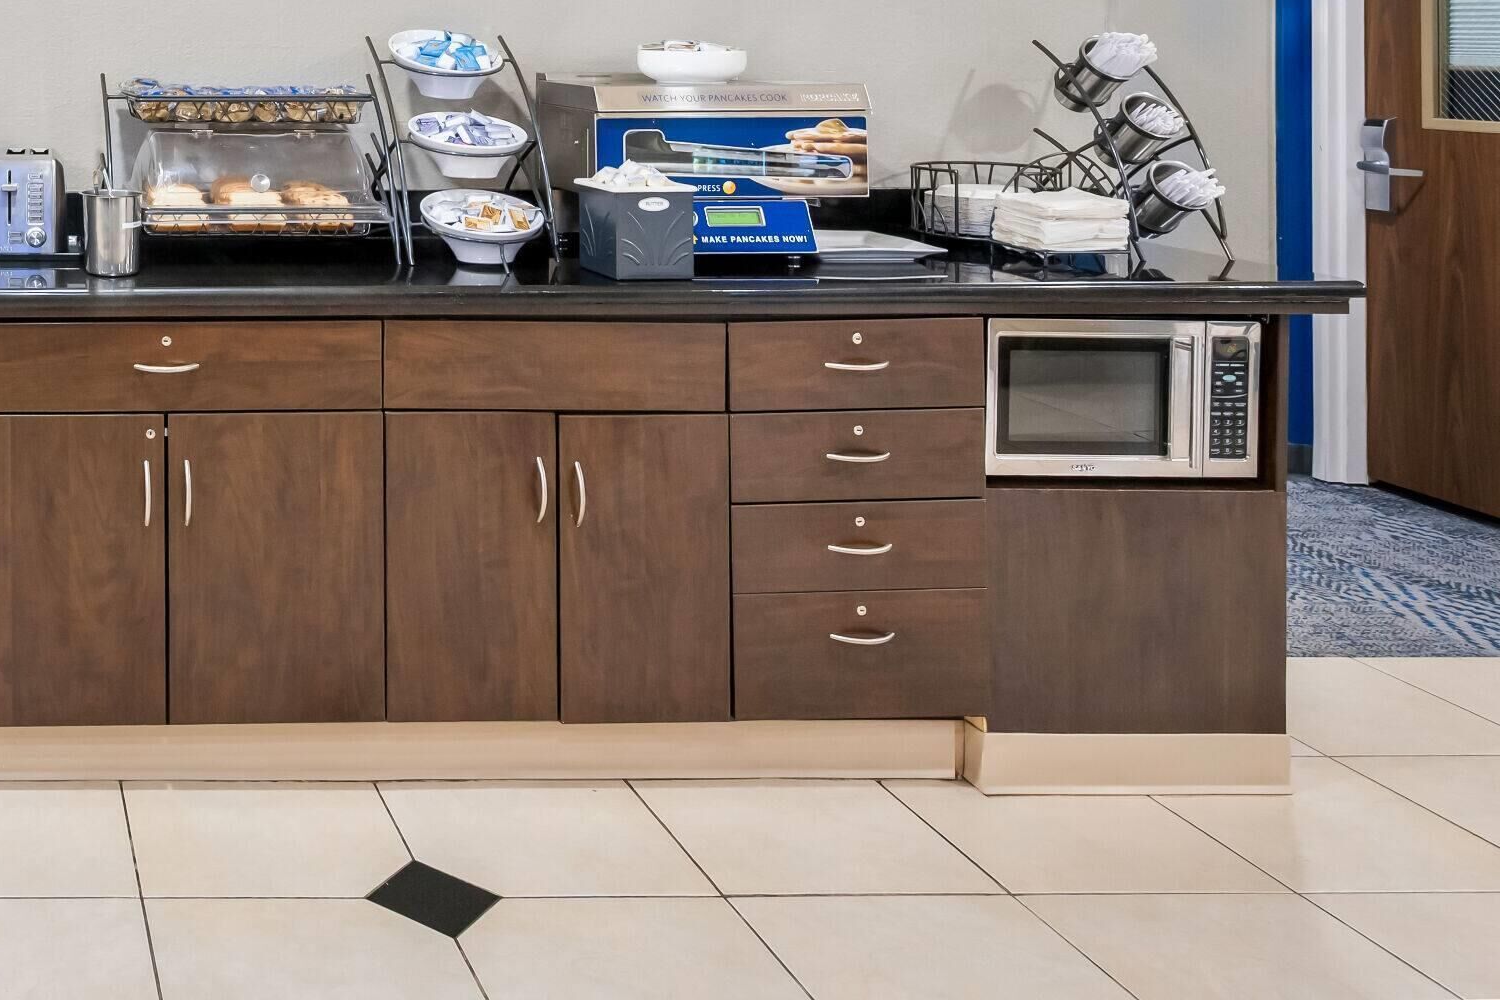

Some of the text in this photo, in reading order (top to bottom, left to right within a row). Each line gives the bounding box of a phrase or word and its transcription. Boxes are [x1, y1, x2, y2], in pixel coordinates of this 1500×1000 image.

[641, 93, 788, 103] WATCH YOUR PANCAKES COOK
[698, 184, 721, 192] PRESS
[701, 235, 808, 243] MAKE PANCAKES NOW!
